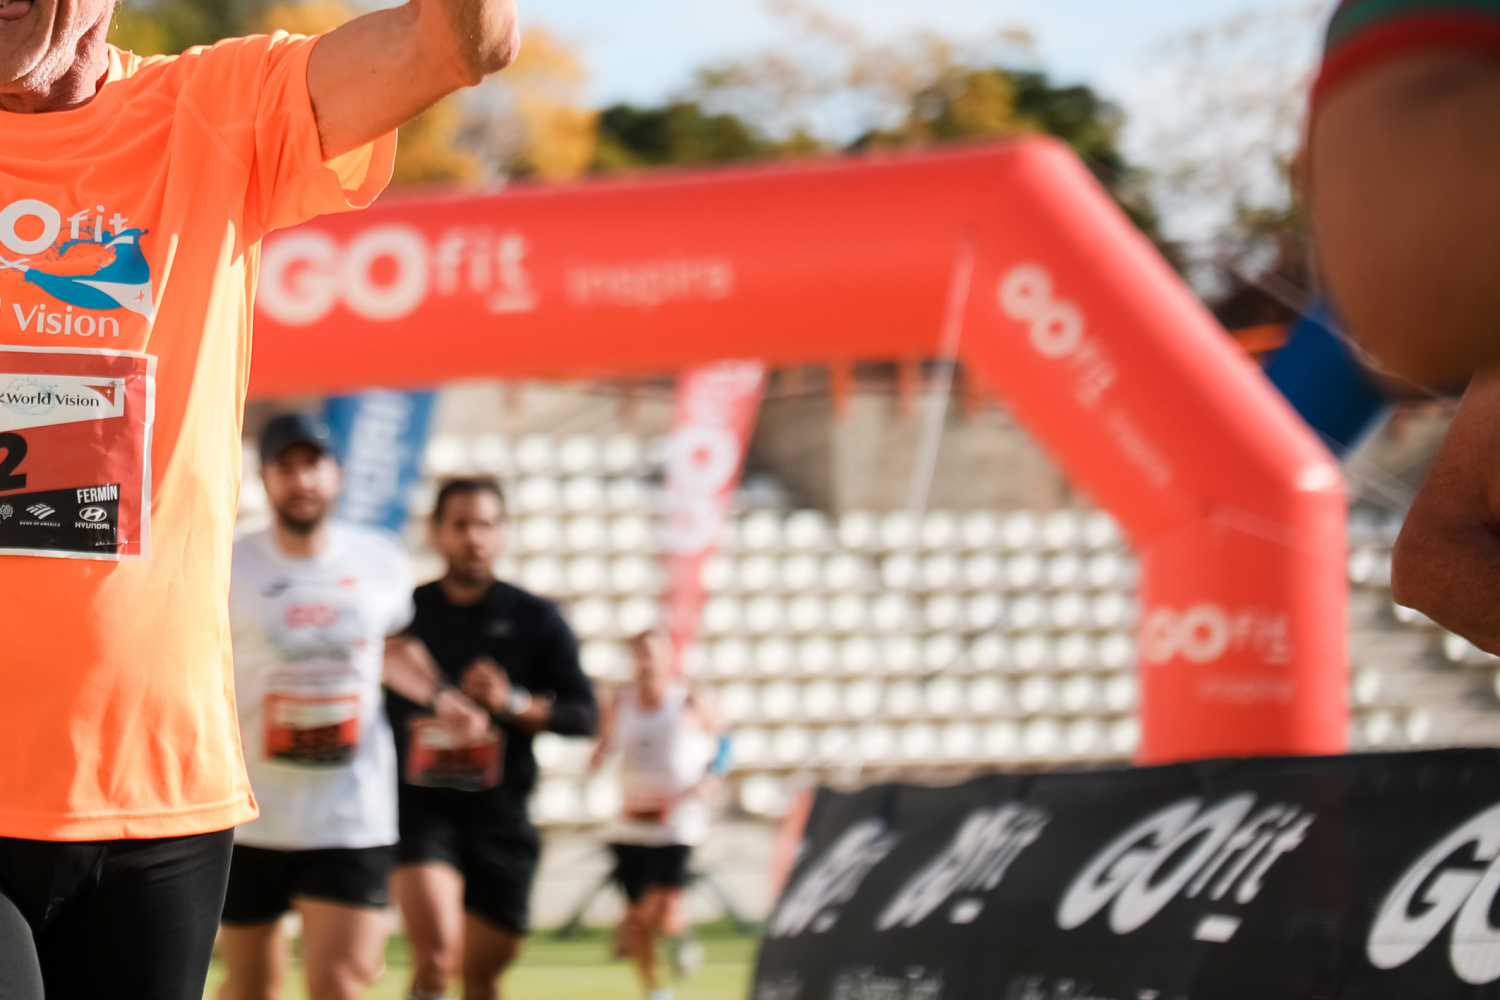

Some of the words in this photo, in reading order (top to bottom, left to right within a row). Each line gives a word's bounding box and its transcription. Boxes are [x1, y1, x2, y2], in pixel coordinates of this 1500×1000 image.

[12, 302, 121, 338] Vision
[6, 390, 52, 405] World
[54, 393, 100, 408] Vision
[76, 483, 119, 504] FERMÍN
[75, 522, 110, 530] HYUNDAI
